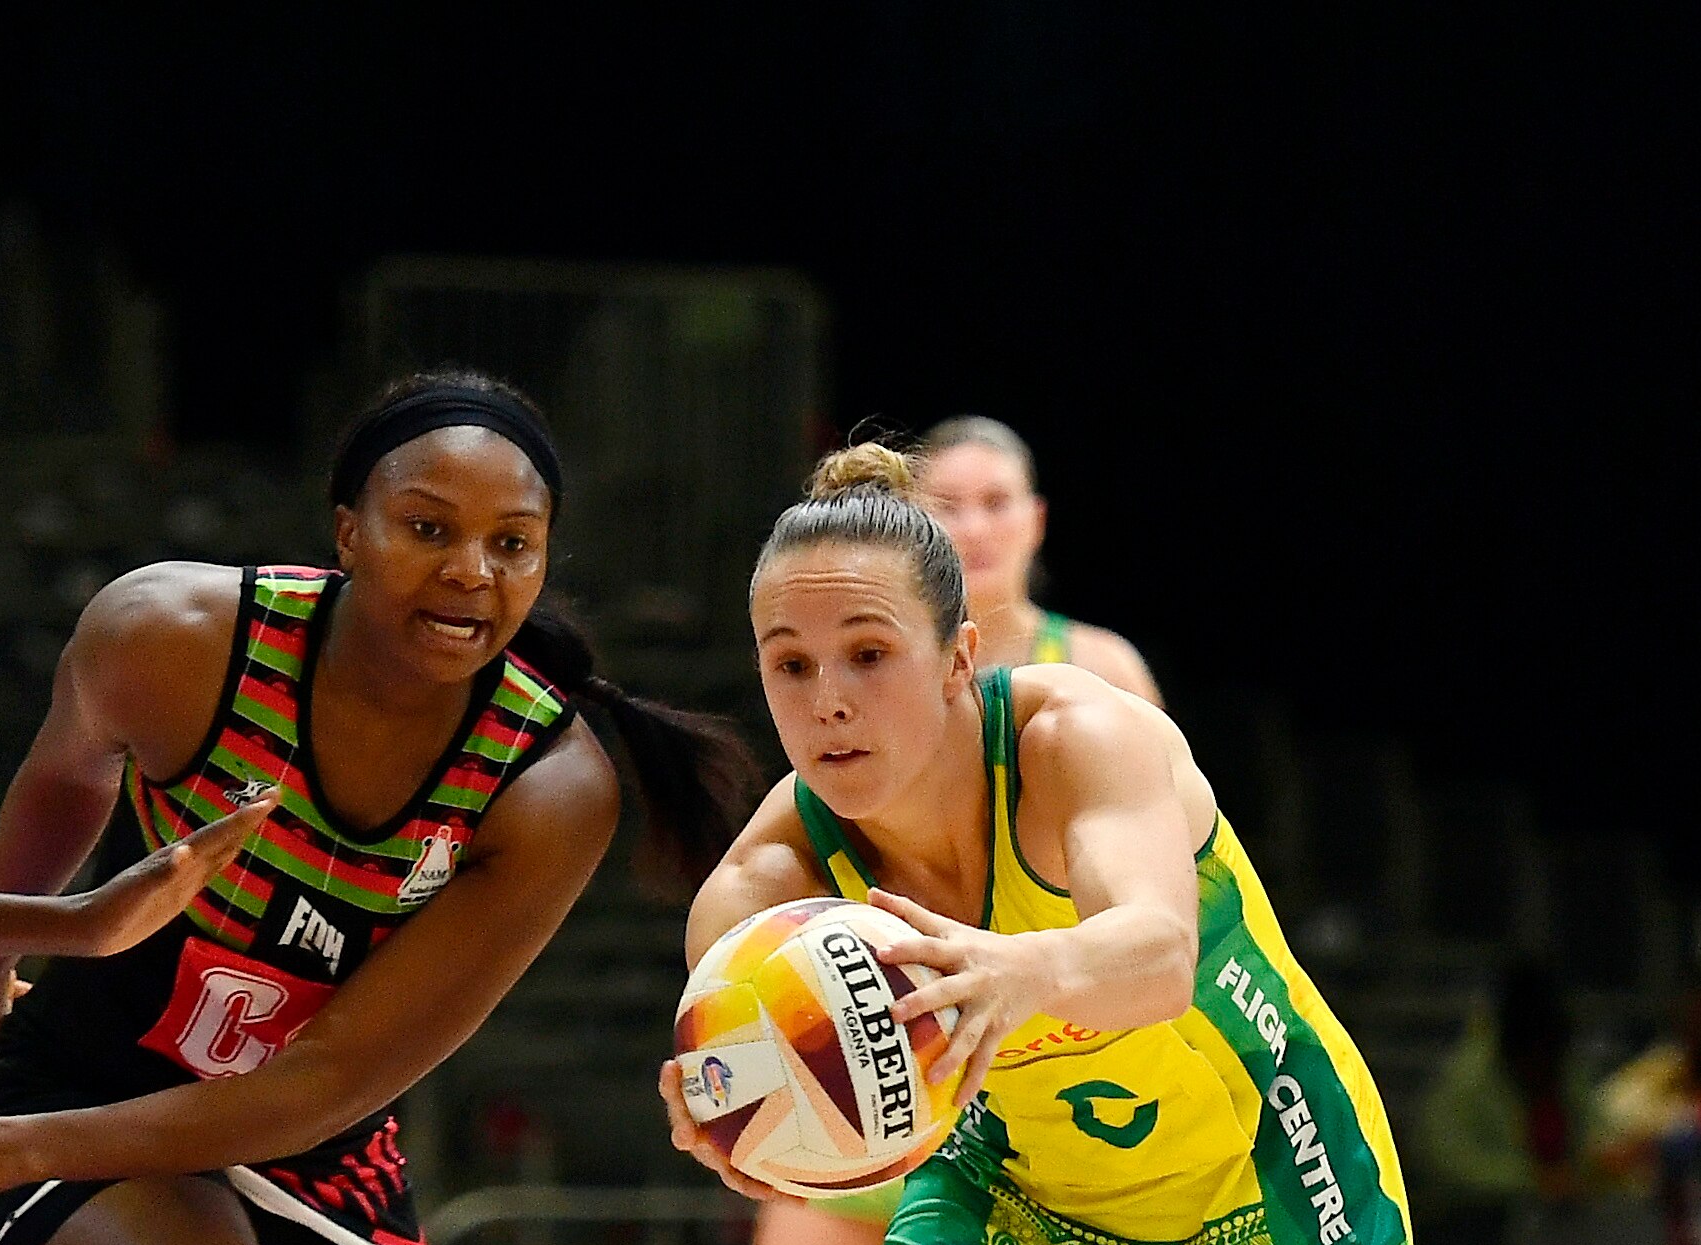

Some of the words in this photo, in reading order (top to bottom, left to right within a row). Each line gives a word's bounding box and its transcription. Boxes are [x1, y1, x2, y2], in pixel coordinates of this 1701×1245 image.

[821, 931, 915, 1141] GILBERT
[841, 1005, 871, 1070] KGANYA
[1215, 955, 1289, 1069] FLIGH
[1054, 1079, 1160, 1150] C
